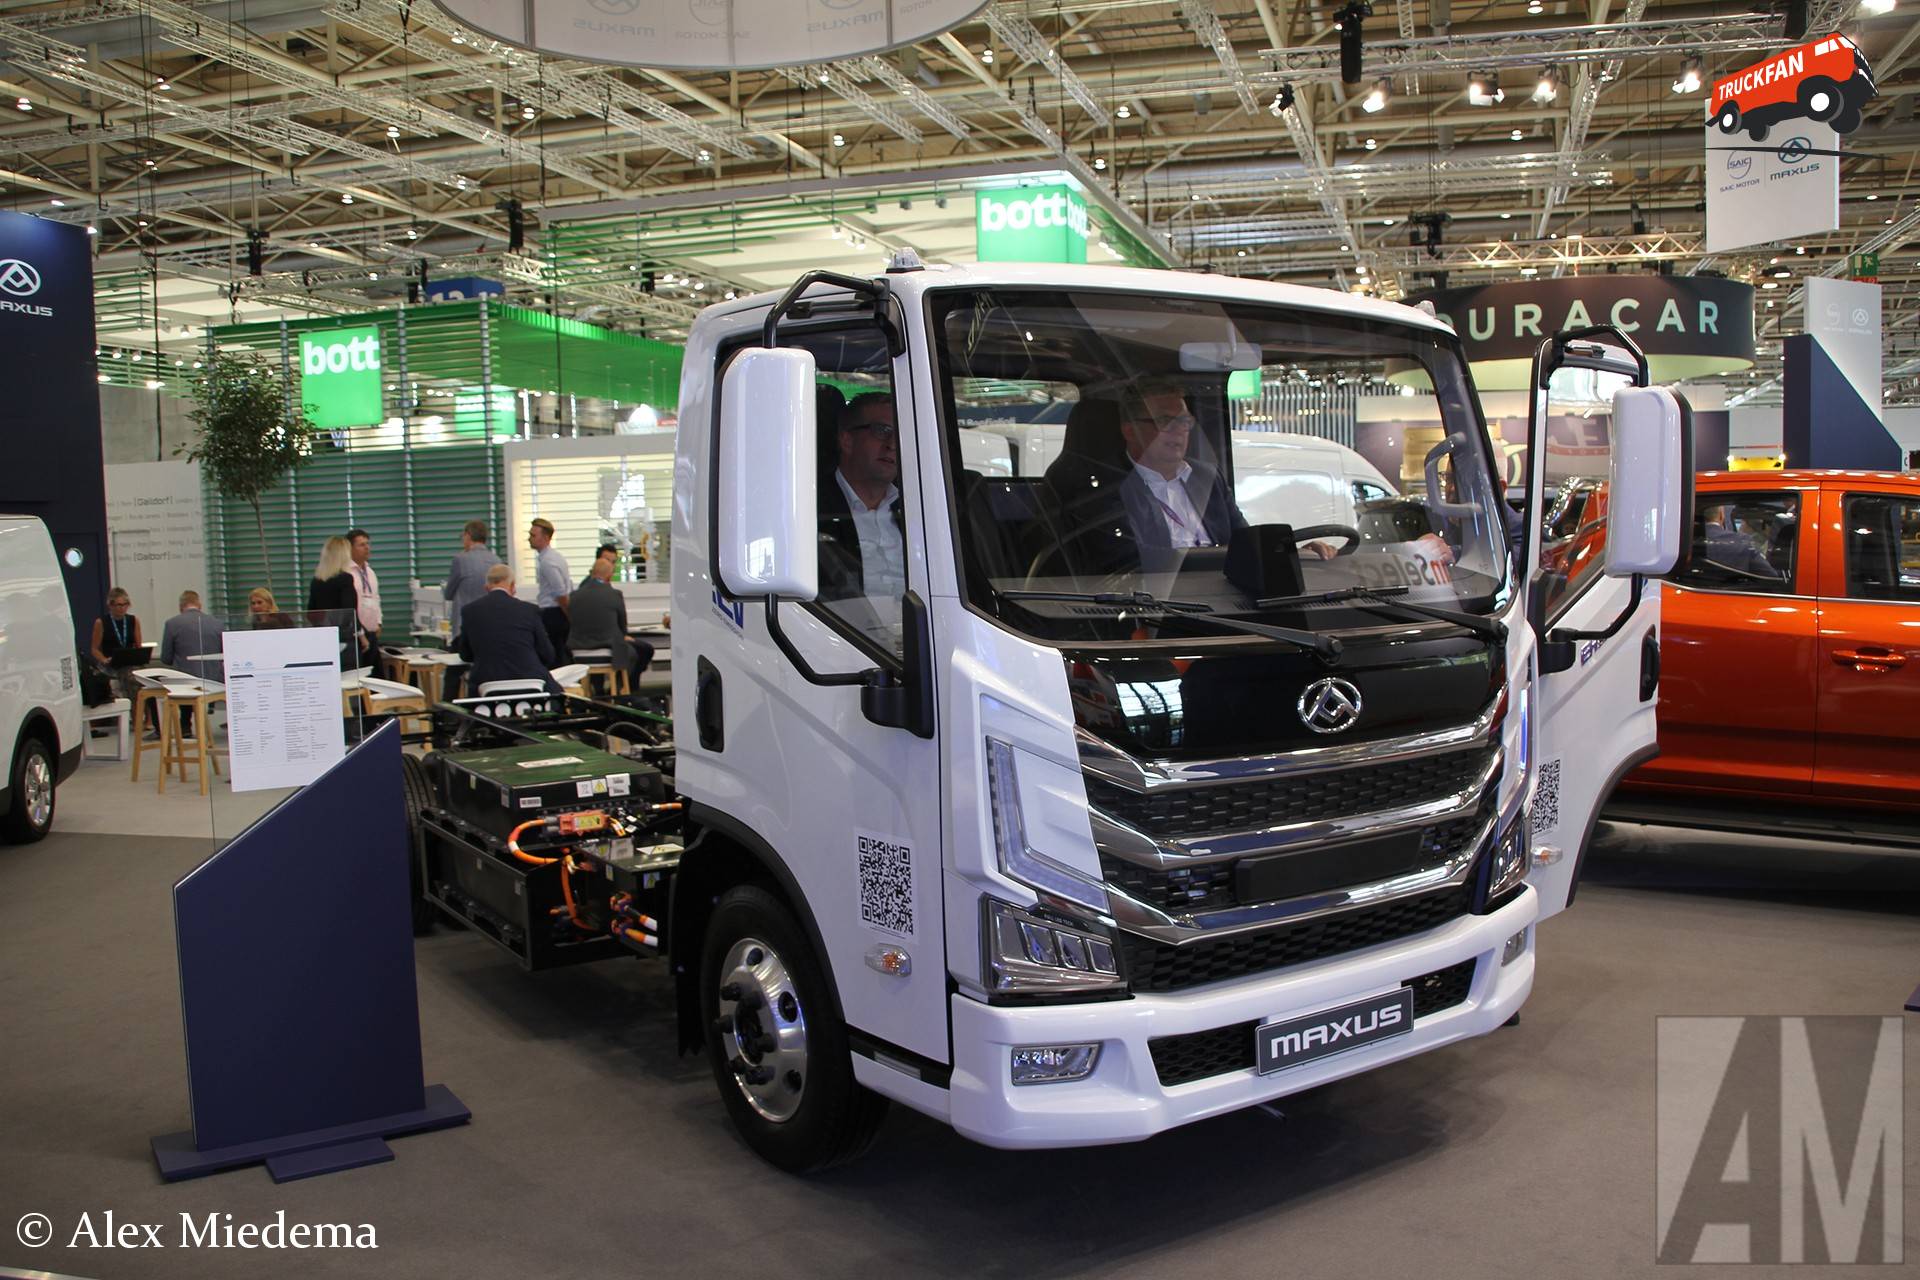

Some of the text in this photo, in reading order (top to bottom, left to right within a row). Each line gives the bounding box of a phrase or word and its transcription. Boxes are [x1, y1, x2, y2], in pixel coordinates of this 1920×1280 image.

[1769, 162, 1820, 181] MAXUS
[981, 192, 1066, 232] bott
[0, 300, 53, 317] AXUS
[303, 335, 381, 376] bott
[1271, 1003, 1402, 1060] MAXUS
